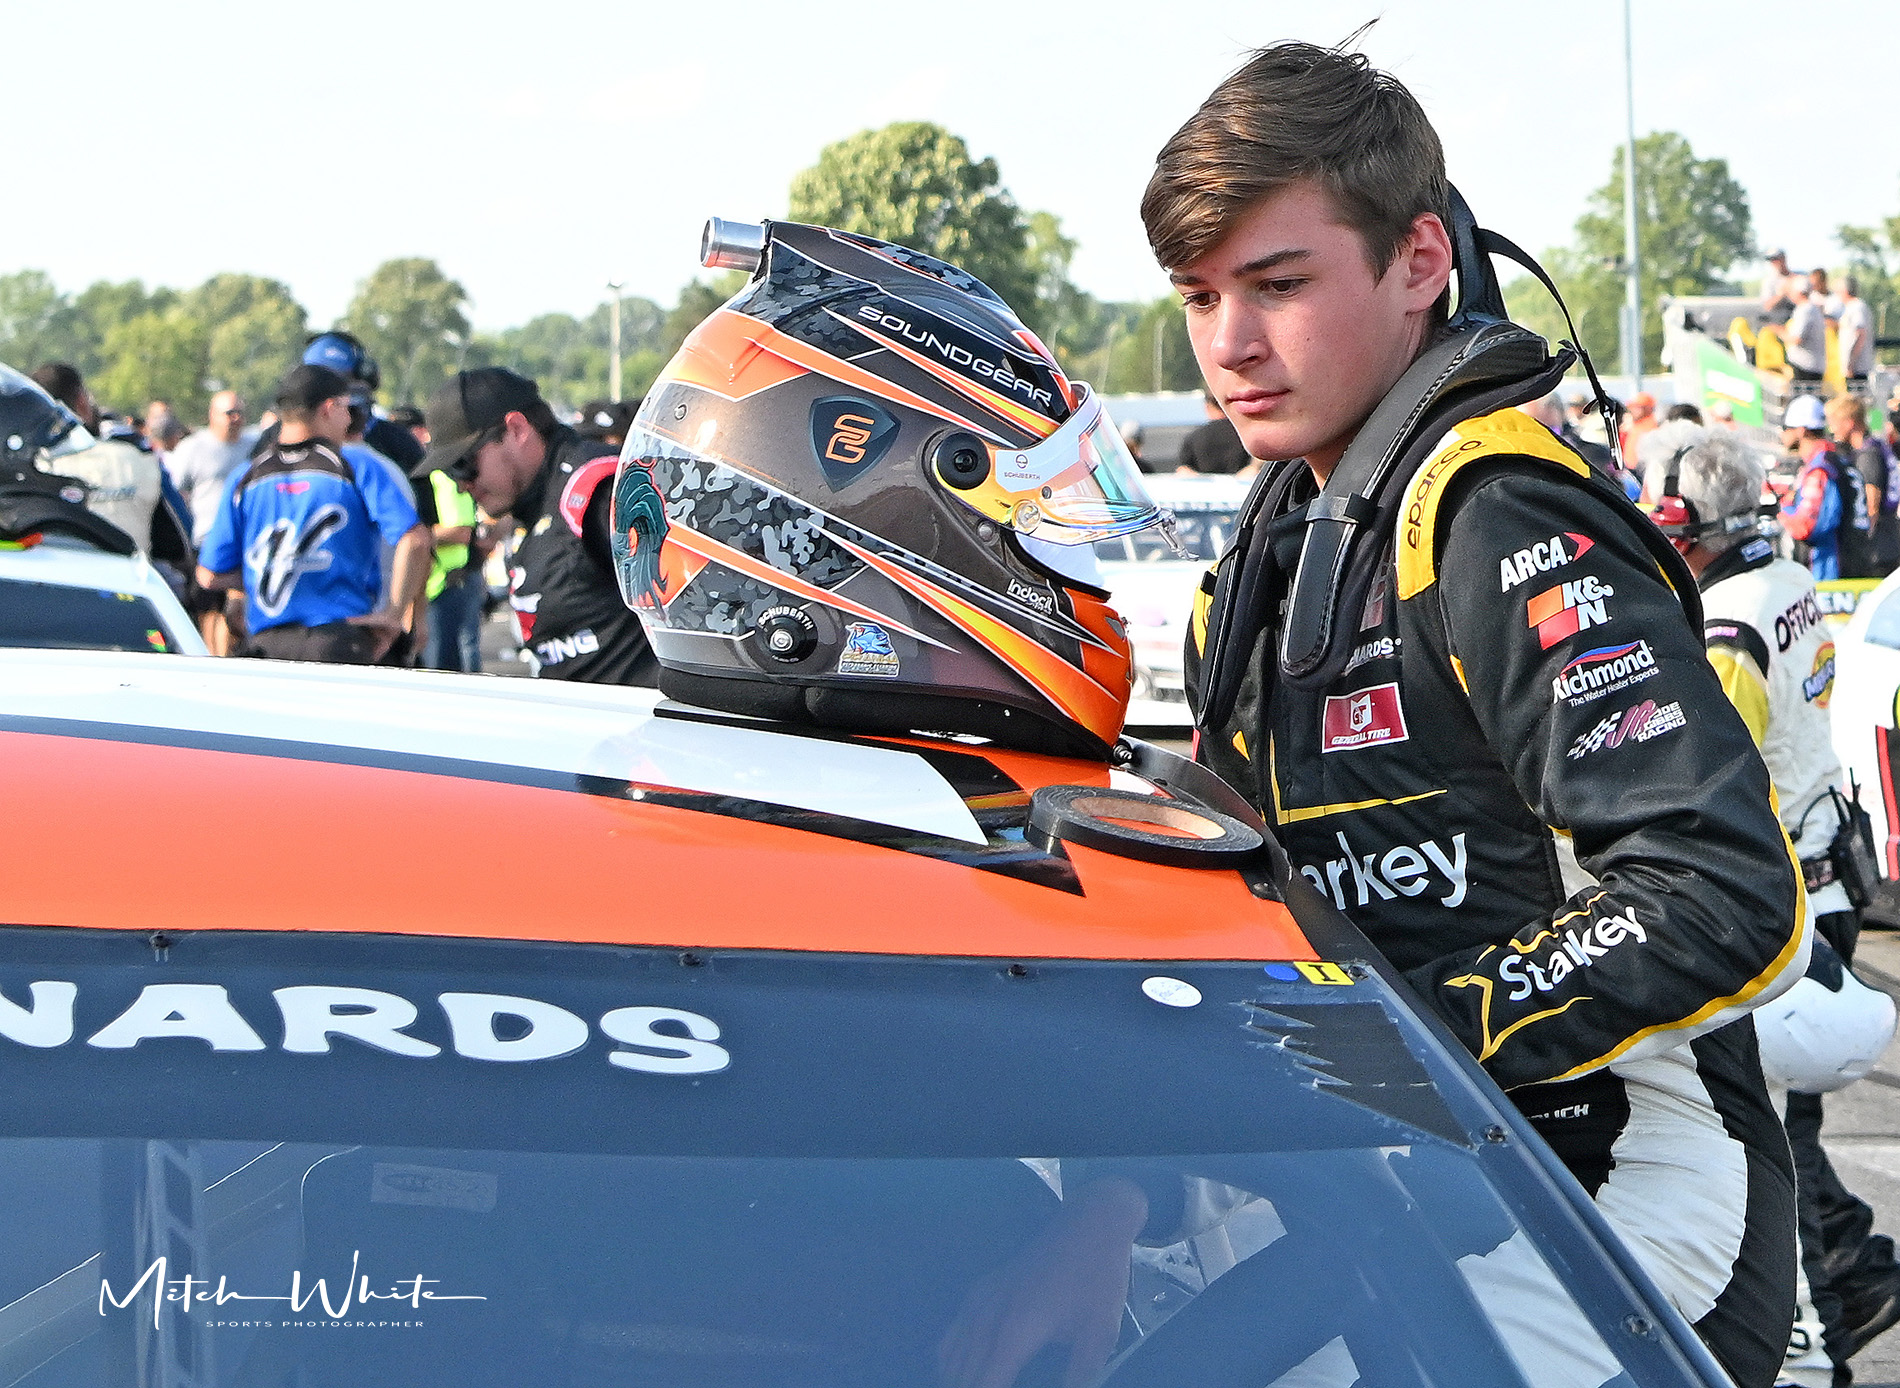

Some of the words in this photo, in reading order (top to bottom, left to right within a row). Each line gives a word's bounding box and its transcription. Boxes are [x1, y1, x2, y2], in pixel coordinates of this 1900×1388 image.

[858, 305, 1053, 408] SOUNDGEAR
[1500, 535, 1569, 593] ARCA
[757, 605, 814, 630] SCHUBERTH
[1552, 639, 1656, 704] Richmond
[1568, 697, 1585, 708] The
[1583, 687, 1607, 702] Water
[1628, 666, 1660, 684] Experts
[1637, 715, 1688, 743] RACING
